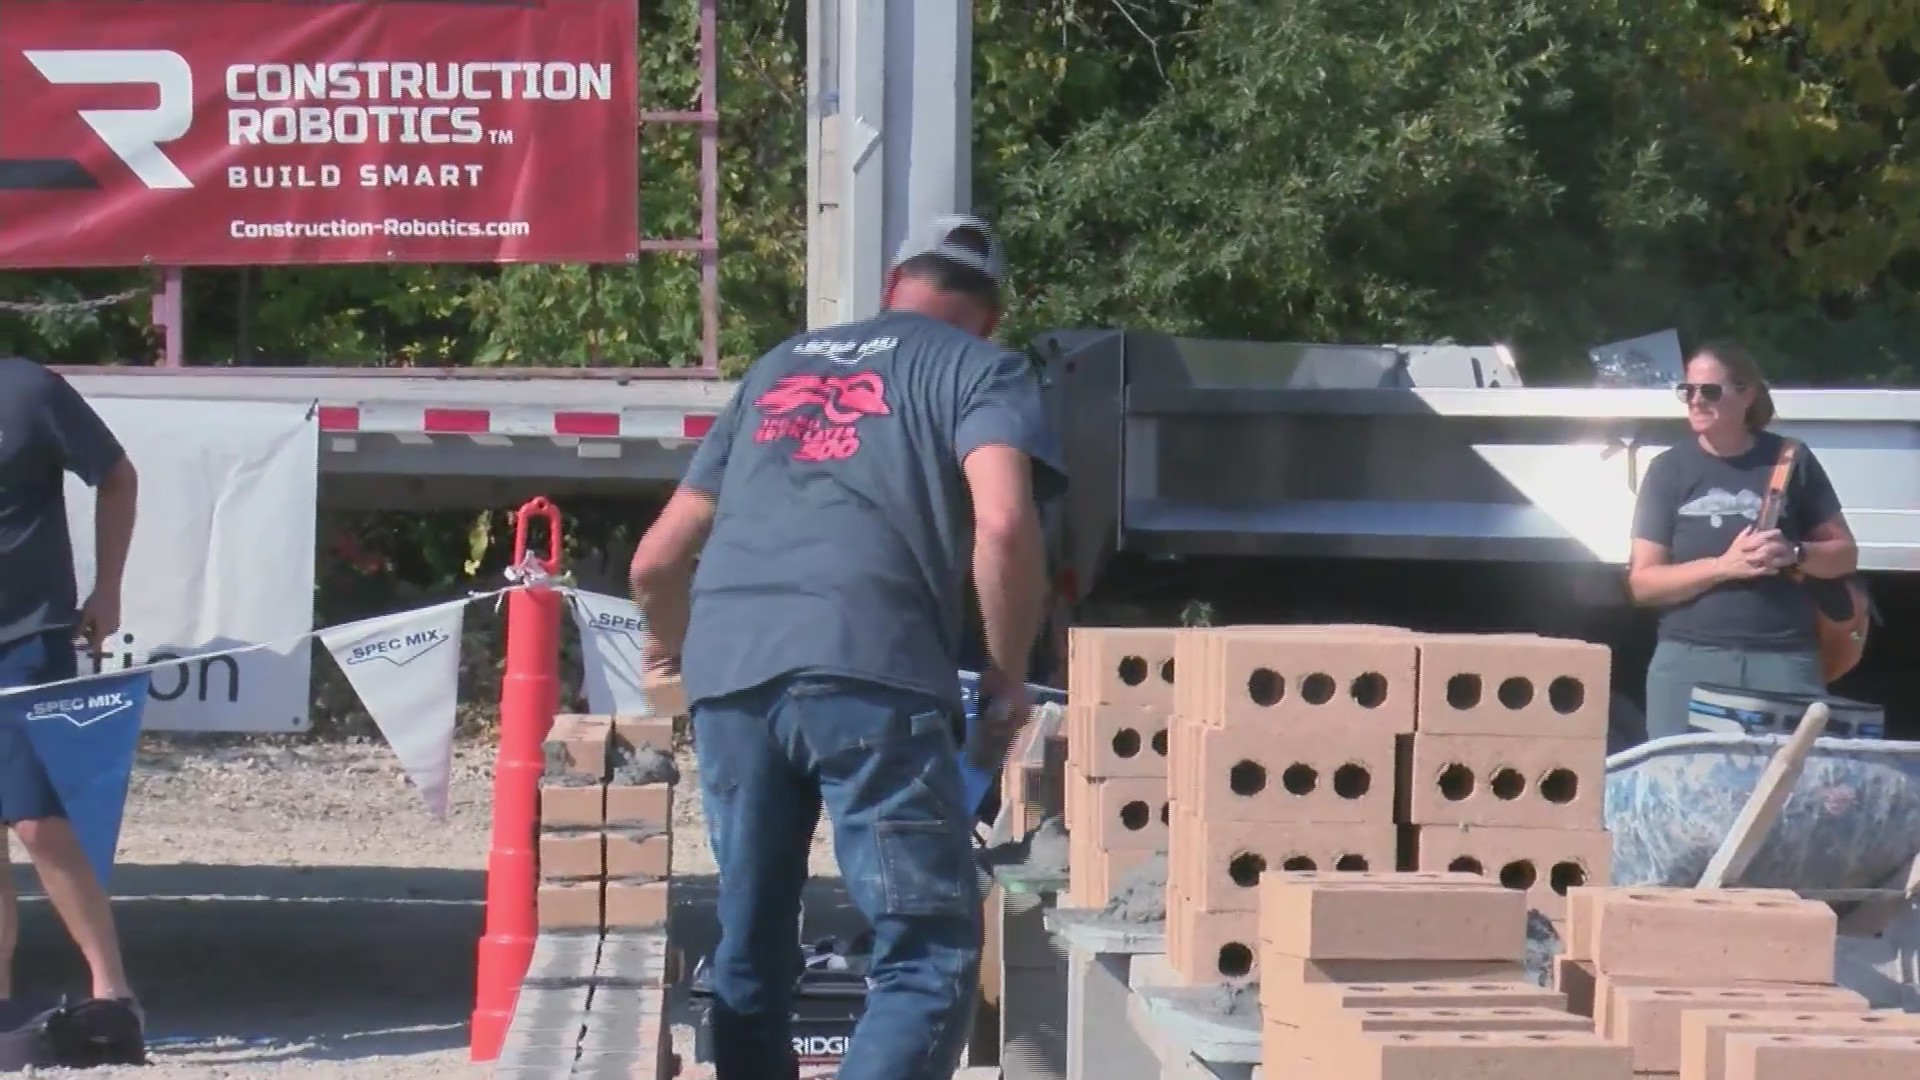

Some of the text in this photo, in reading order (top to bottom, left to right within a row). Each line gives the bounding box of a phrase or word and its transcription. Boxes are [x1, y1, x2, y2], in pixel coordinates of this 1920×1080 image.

[226, 62, 611, 101] CONSTRUCTION
[228, 106, 483, 145] ROBOTICS
[228, 164, 482, 188] BUILD SMART
[231, 218, 529, 238] Construction-Robotics.com
[353, 630, 438, 658] SPEC MIX
[33, 692, 122, 715] SPEC MIX
